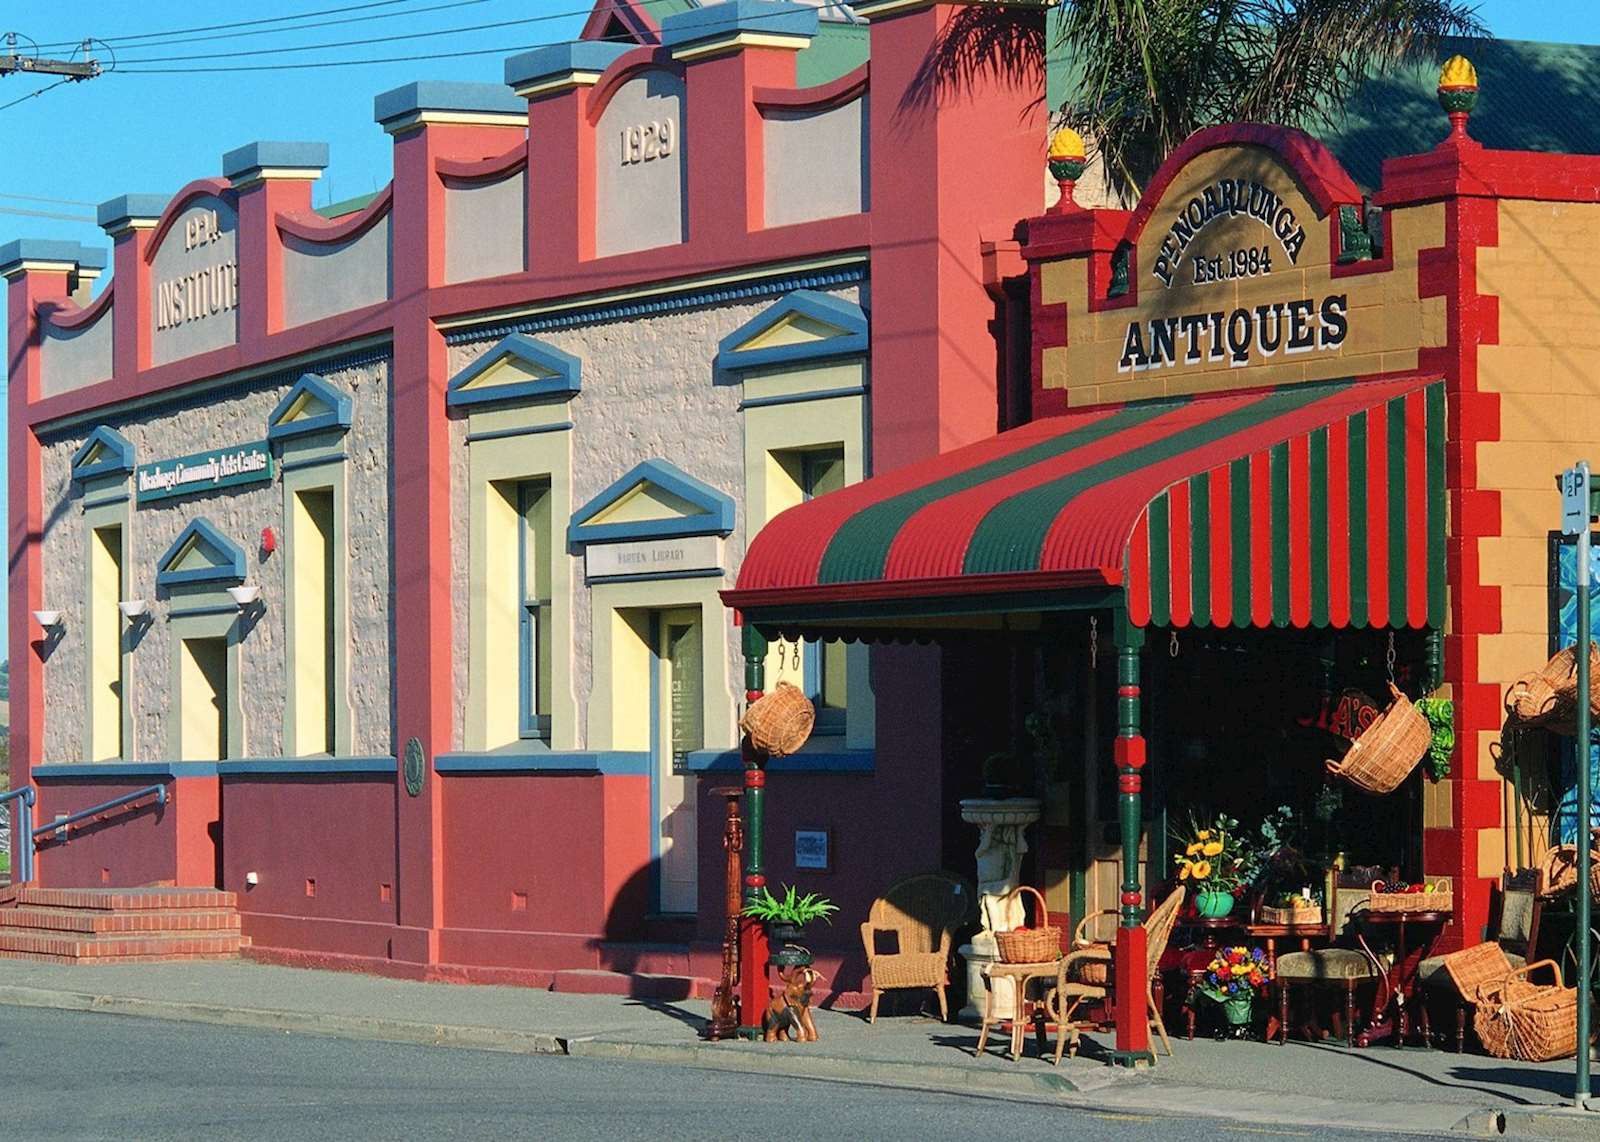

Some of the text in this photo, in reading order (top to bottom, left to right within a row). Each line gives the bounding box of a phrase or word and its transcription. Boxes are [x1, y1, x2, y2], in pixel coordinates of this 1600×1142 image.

[620, 117, 675, 167] 1929
[1169, 178, 1307, 266] NOARLUNGA
[1117, 294, 1348, 373] ANTIQUES
